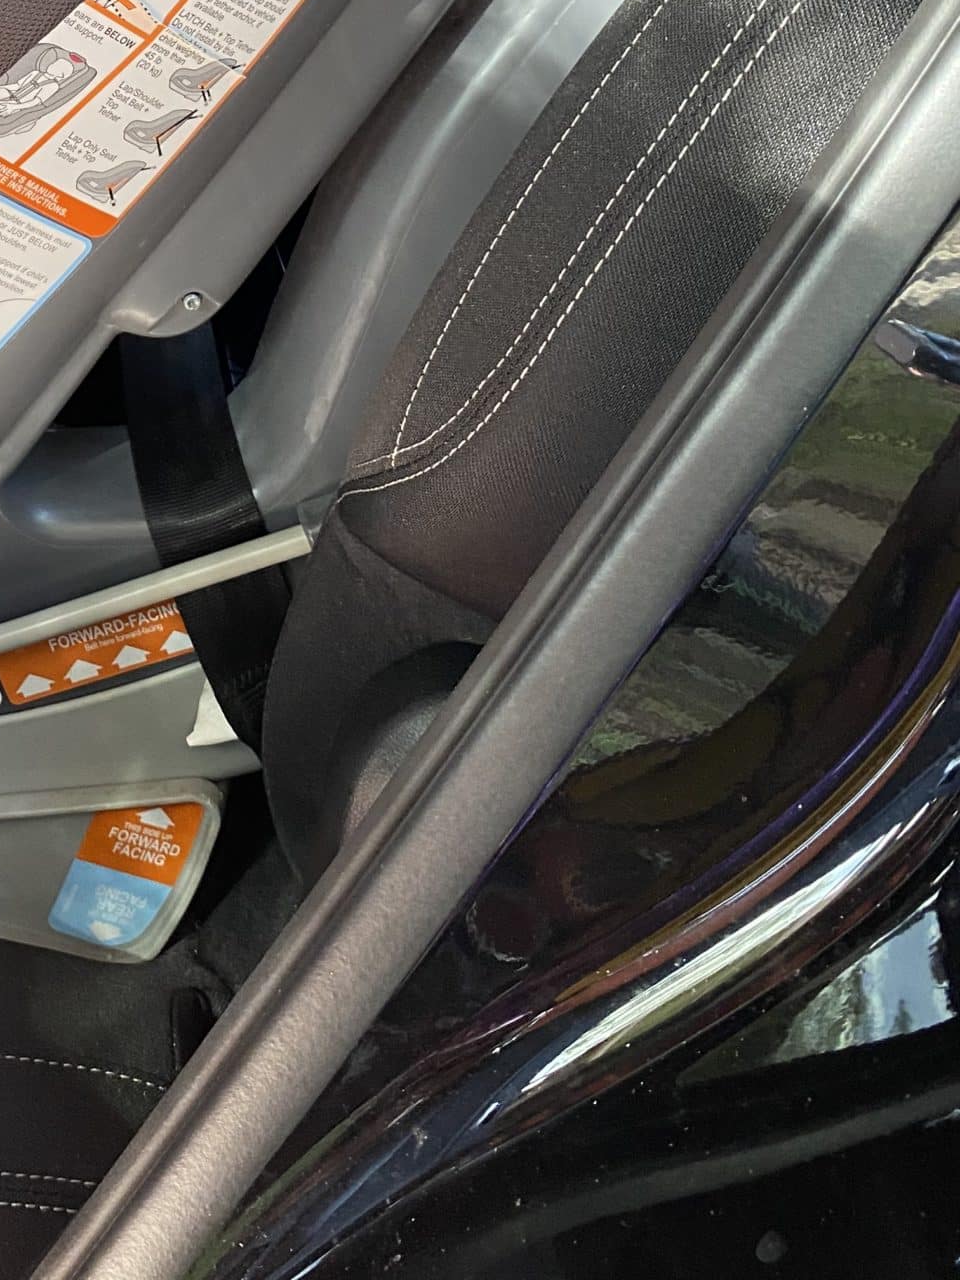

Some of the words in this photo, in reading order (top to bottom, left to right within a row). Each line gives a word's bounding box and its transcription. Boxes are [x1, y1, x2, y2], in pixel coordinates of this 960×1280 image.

[71, 21, 106, 47] support.
[91, 19, 106, 33] are
[102, 25, 137, 51] BELOW
[169, 15, 185, 30] Do
[180, 22, 197, 37] not
[193, 28, 216, 47] install
[210, 39, 225, 54] by
[220, 44, 236, 59] this
[177, 6, 206, 29] LATCH
[201, 20, 220, 38] Belt
[220, 31, 238, 48] Top
[233, 38, 257, 58] Tether
[142, 48, 157, 63] 45
[153, 54, 164, 66] lb
[149, 40, 174, 60] more
[170, 51, 187, 67] than
[134, 56, 151, 72] (20
[146, 63, 164, 81] kg)
[102, 95, 121, 113] Top
[109, 86, 131, 106] Seat
[126, 96, 145, 113] Belt
[116, 78, 165, 114] Lap/Shoulder
[96, 104, 122, 125] Tether
[52, 146, 79, 167] Tether
[59, 138, 78, 155] Belt
[80, 149, 98, 166] Top
[65, 130, 85, 148] Lap
[80, 138, 101, 157] Only
[97, 146, 118, 164] Seat
[5, 177, 69, 219] INSTRUCTIONS.
[24, 177, 61, 204] MANUAL
[5, 223, 30, 242] JUST
[26, 233, 58, 256] BELOW
[23, 220, 55, 243] harness
[52, 234, 73, 251] must
[106, 824, 182, 857] FORWARD
[110, 839, 168, 867] FACING
